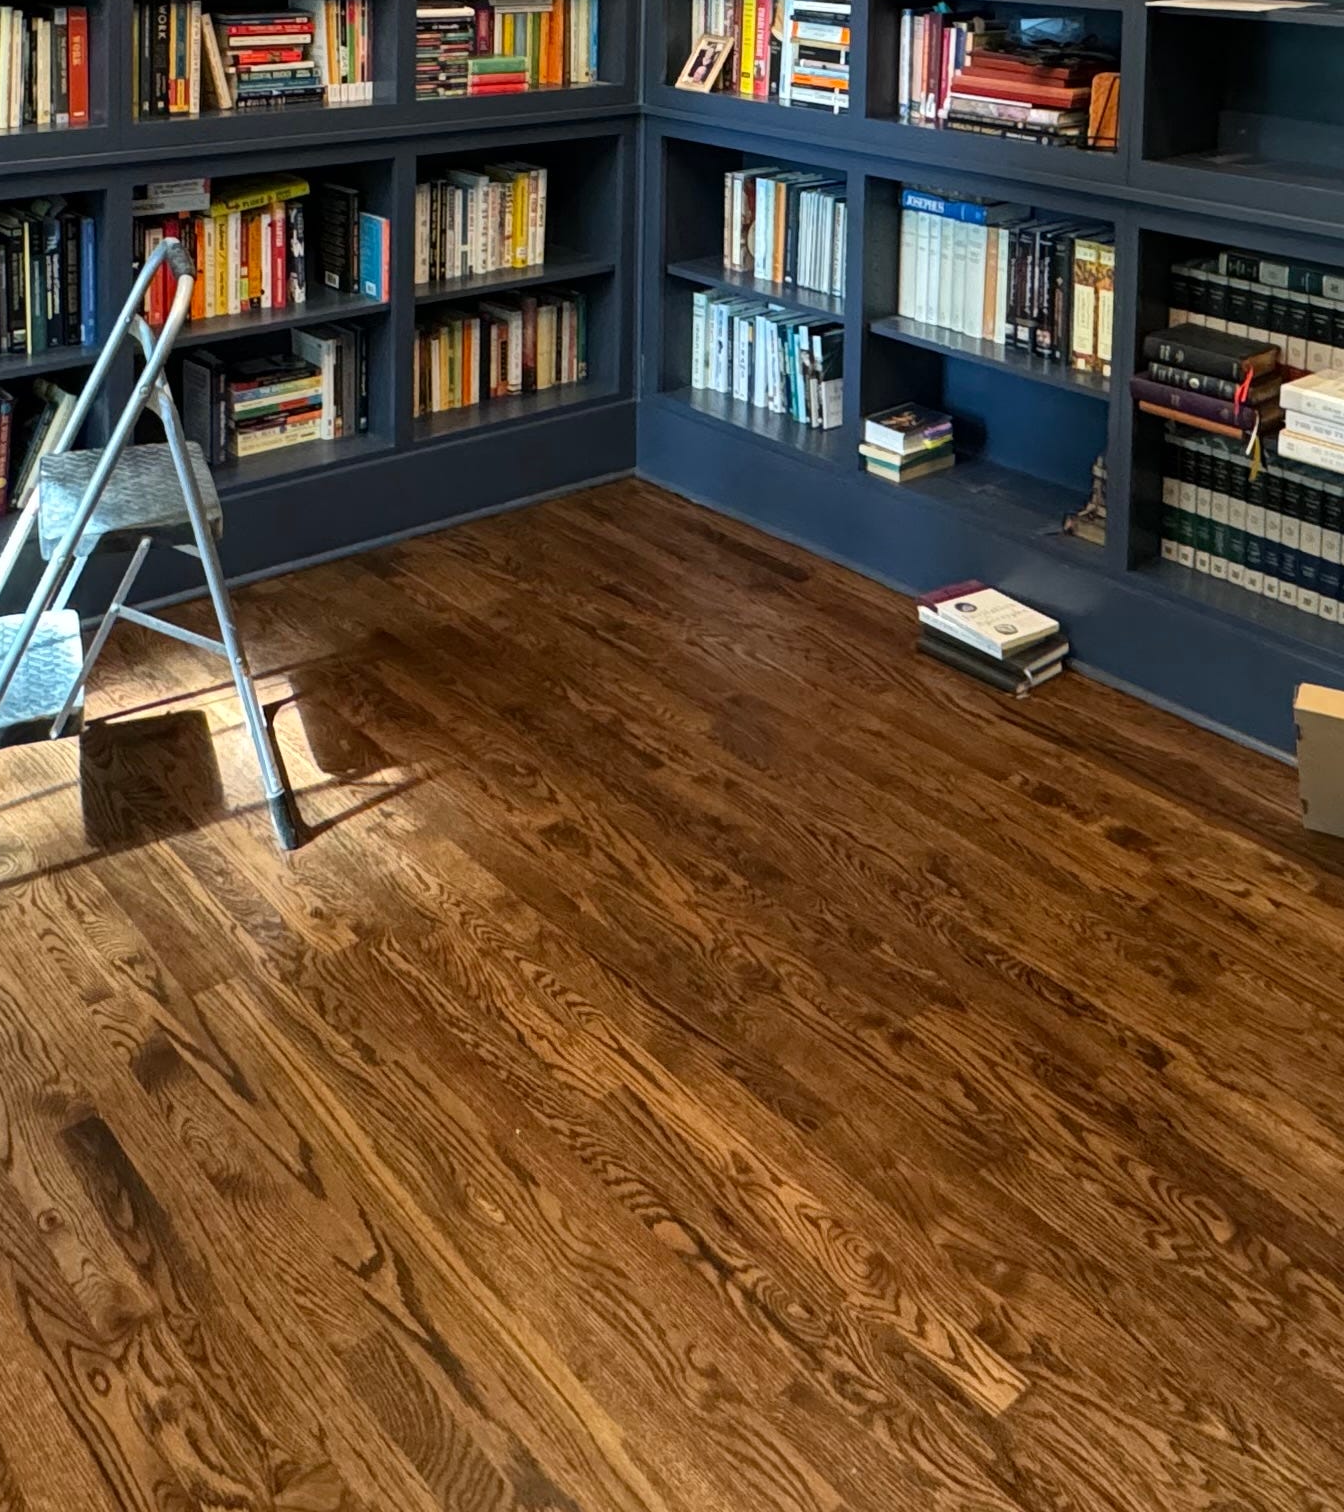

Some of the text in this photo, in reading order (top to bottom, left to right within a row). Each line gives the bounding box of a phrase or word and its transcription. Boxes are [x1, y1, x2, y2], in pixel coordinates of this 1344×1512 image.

[157, 4, 168, 39] WORK
[71, 35, 81, 67] WORK
[905, 194, 946, 215] JOSEPHUS
